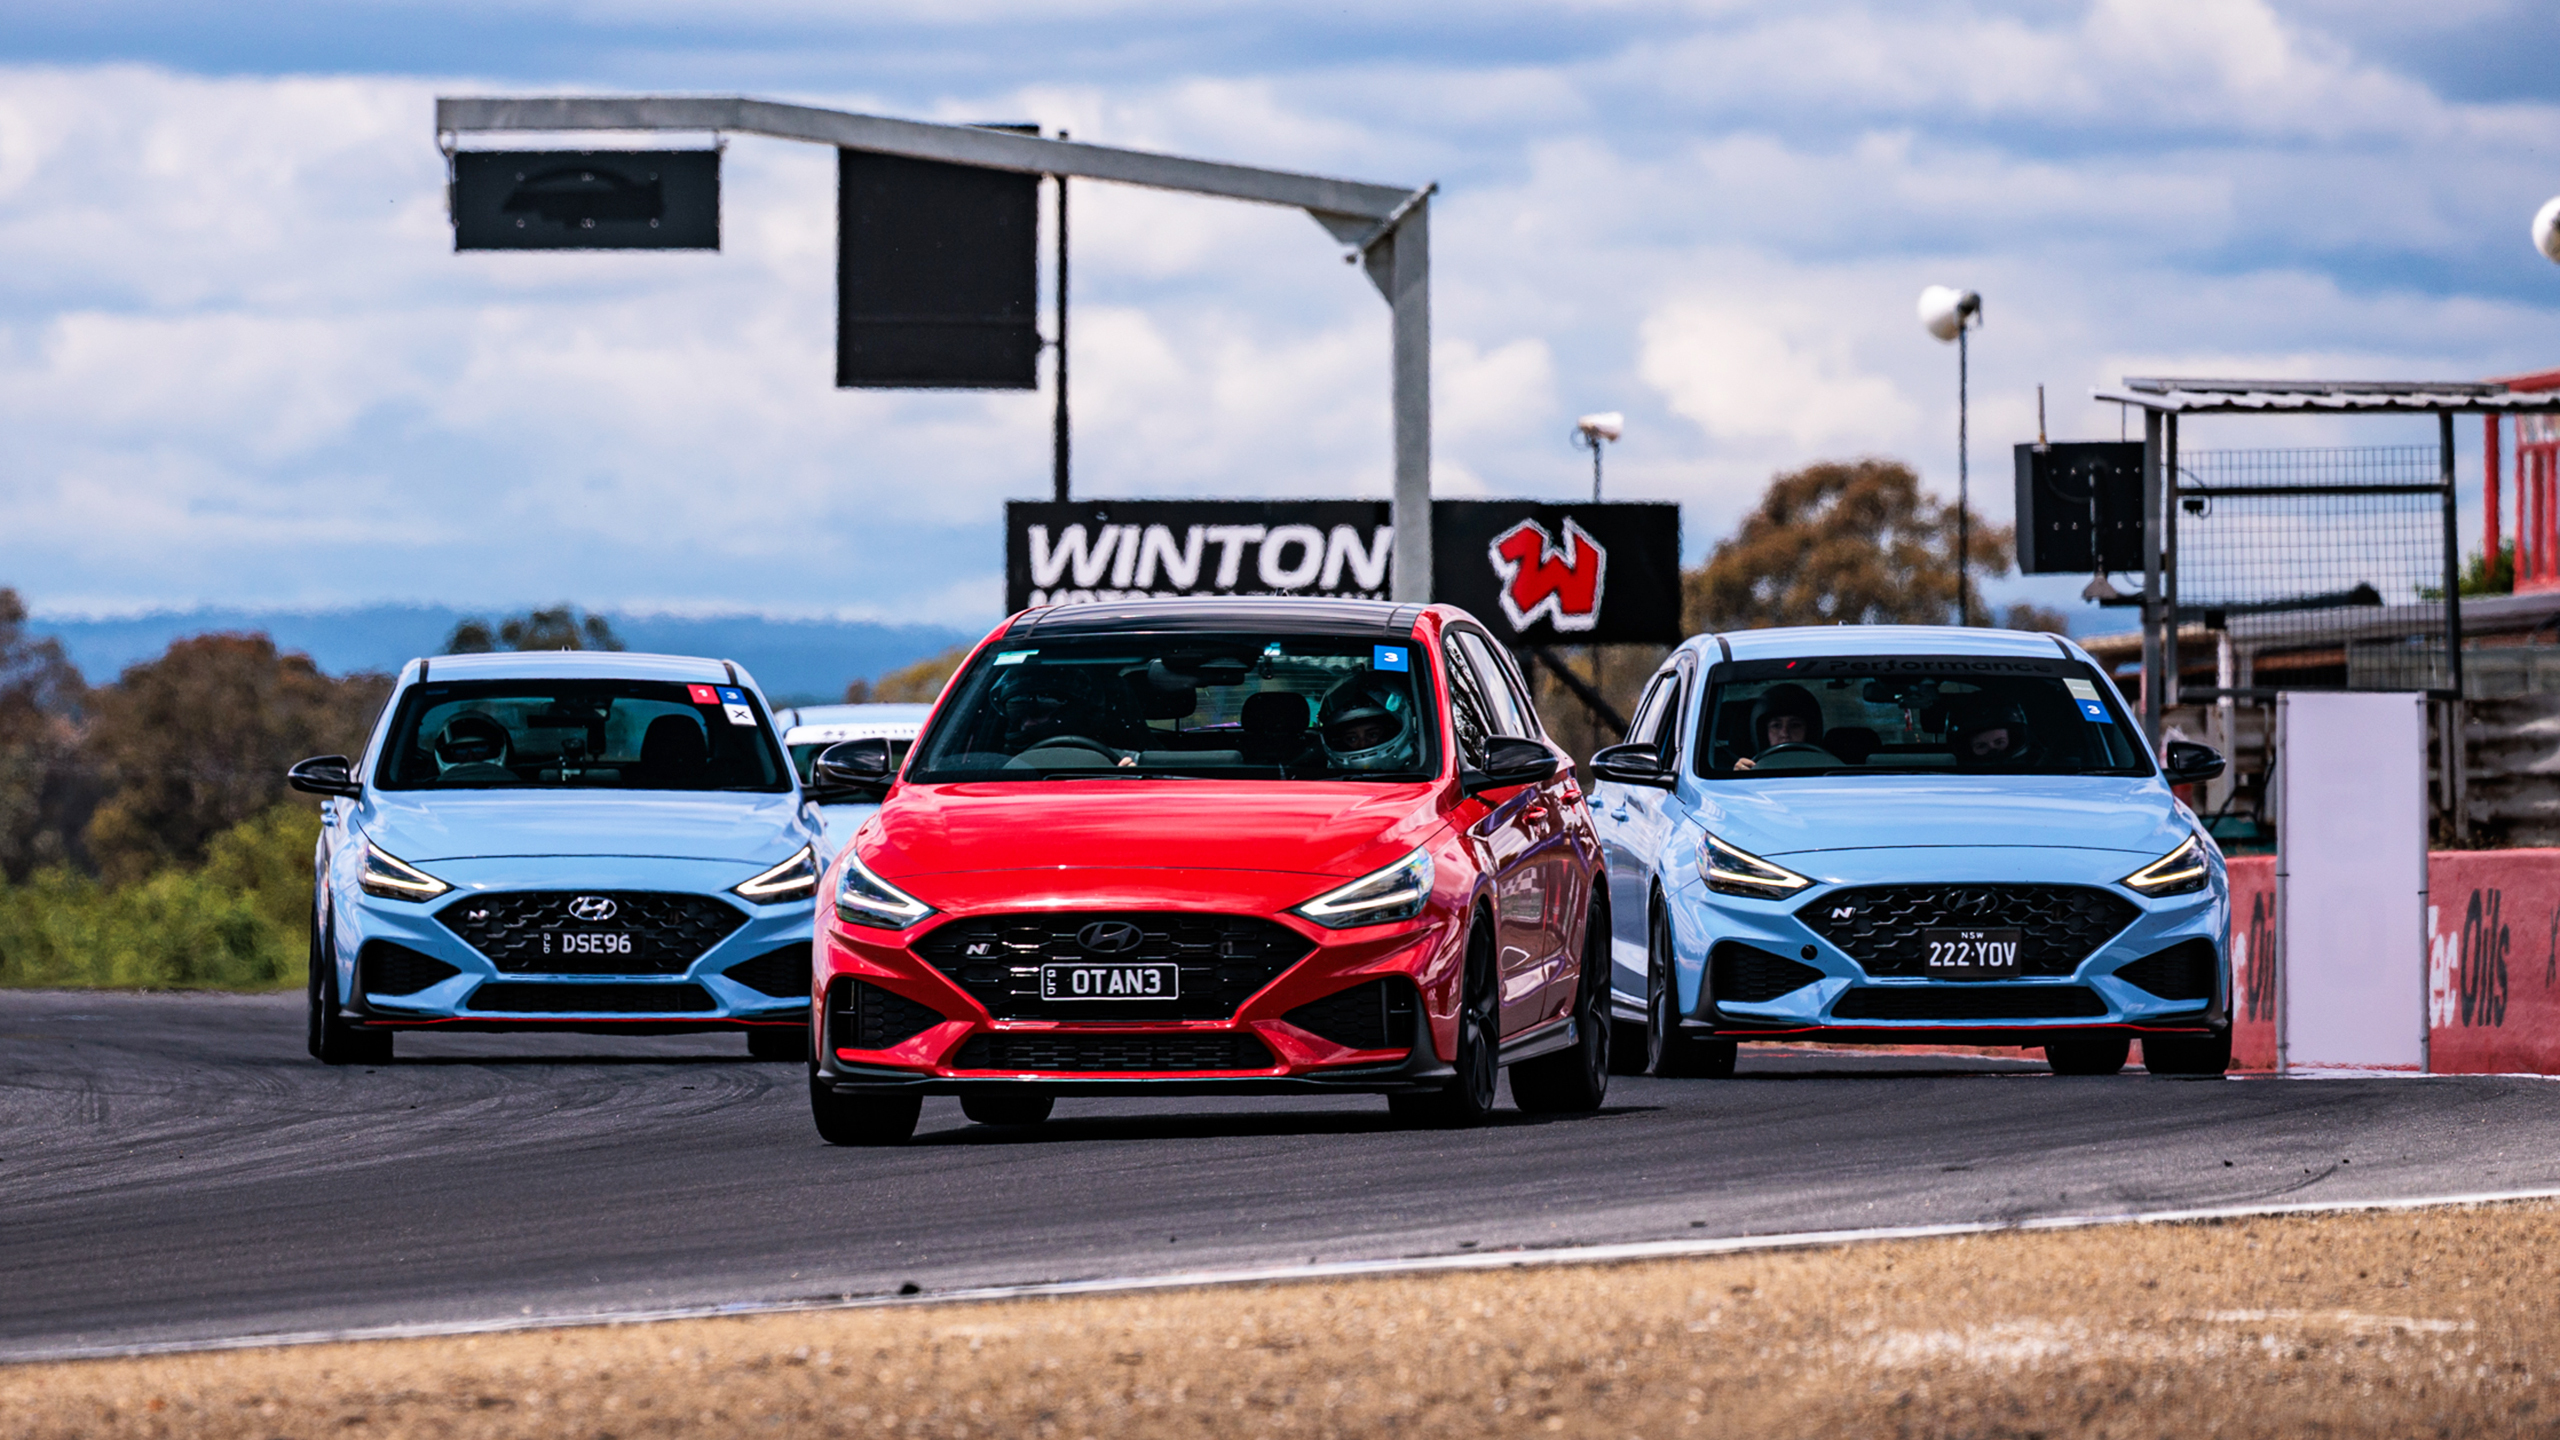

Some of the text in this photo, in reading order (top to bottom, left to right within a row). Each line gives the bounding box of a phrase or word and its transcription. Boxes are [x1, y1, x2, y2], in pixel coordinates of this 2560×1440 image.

[1027, 523, 1393, 590] WINTON
[1384, 652, 1398, 662] 3
[1828, 659, 2053, 673] Performance
[698, 689, 708, 697] 1
[726, 691, 739, 700] 3
[2087, 705, 2100, 715] 3
[562, 933, 632, 954] DSE96
[2248, 891, 2276, 1023] Oil
[2460, 888, 2510, 1028] Oils
